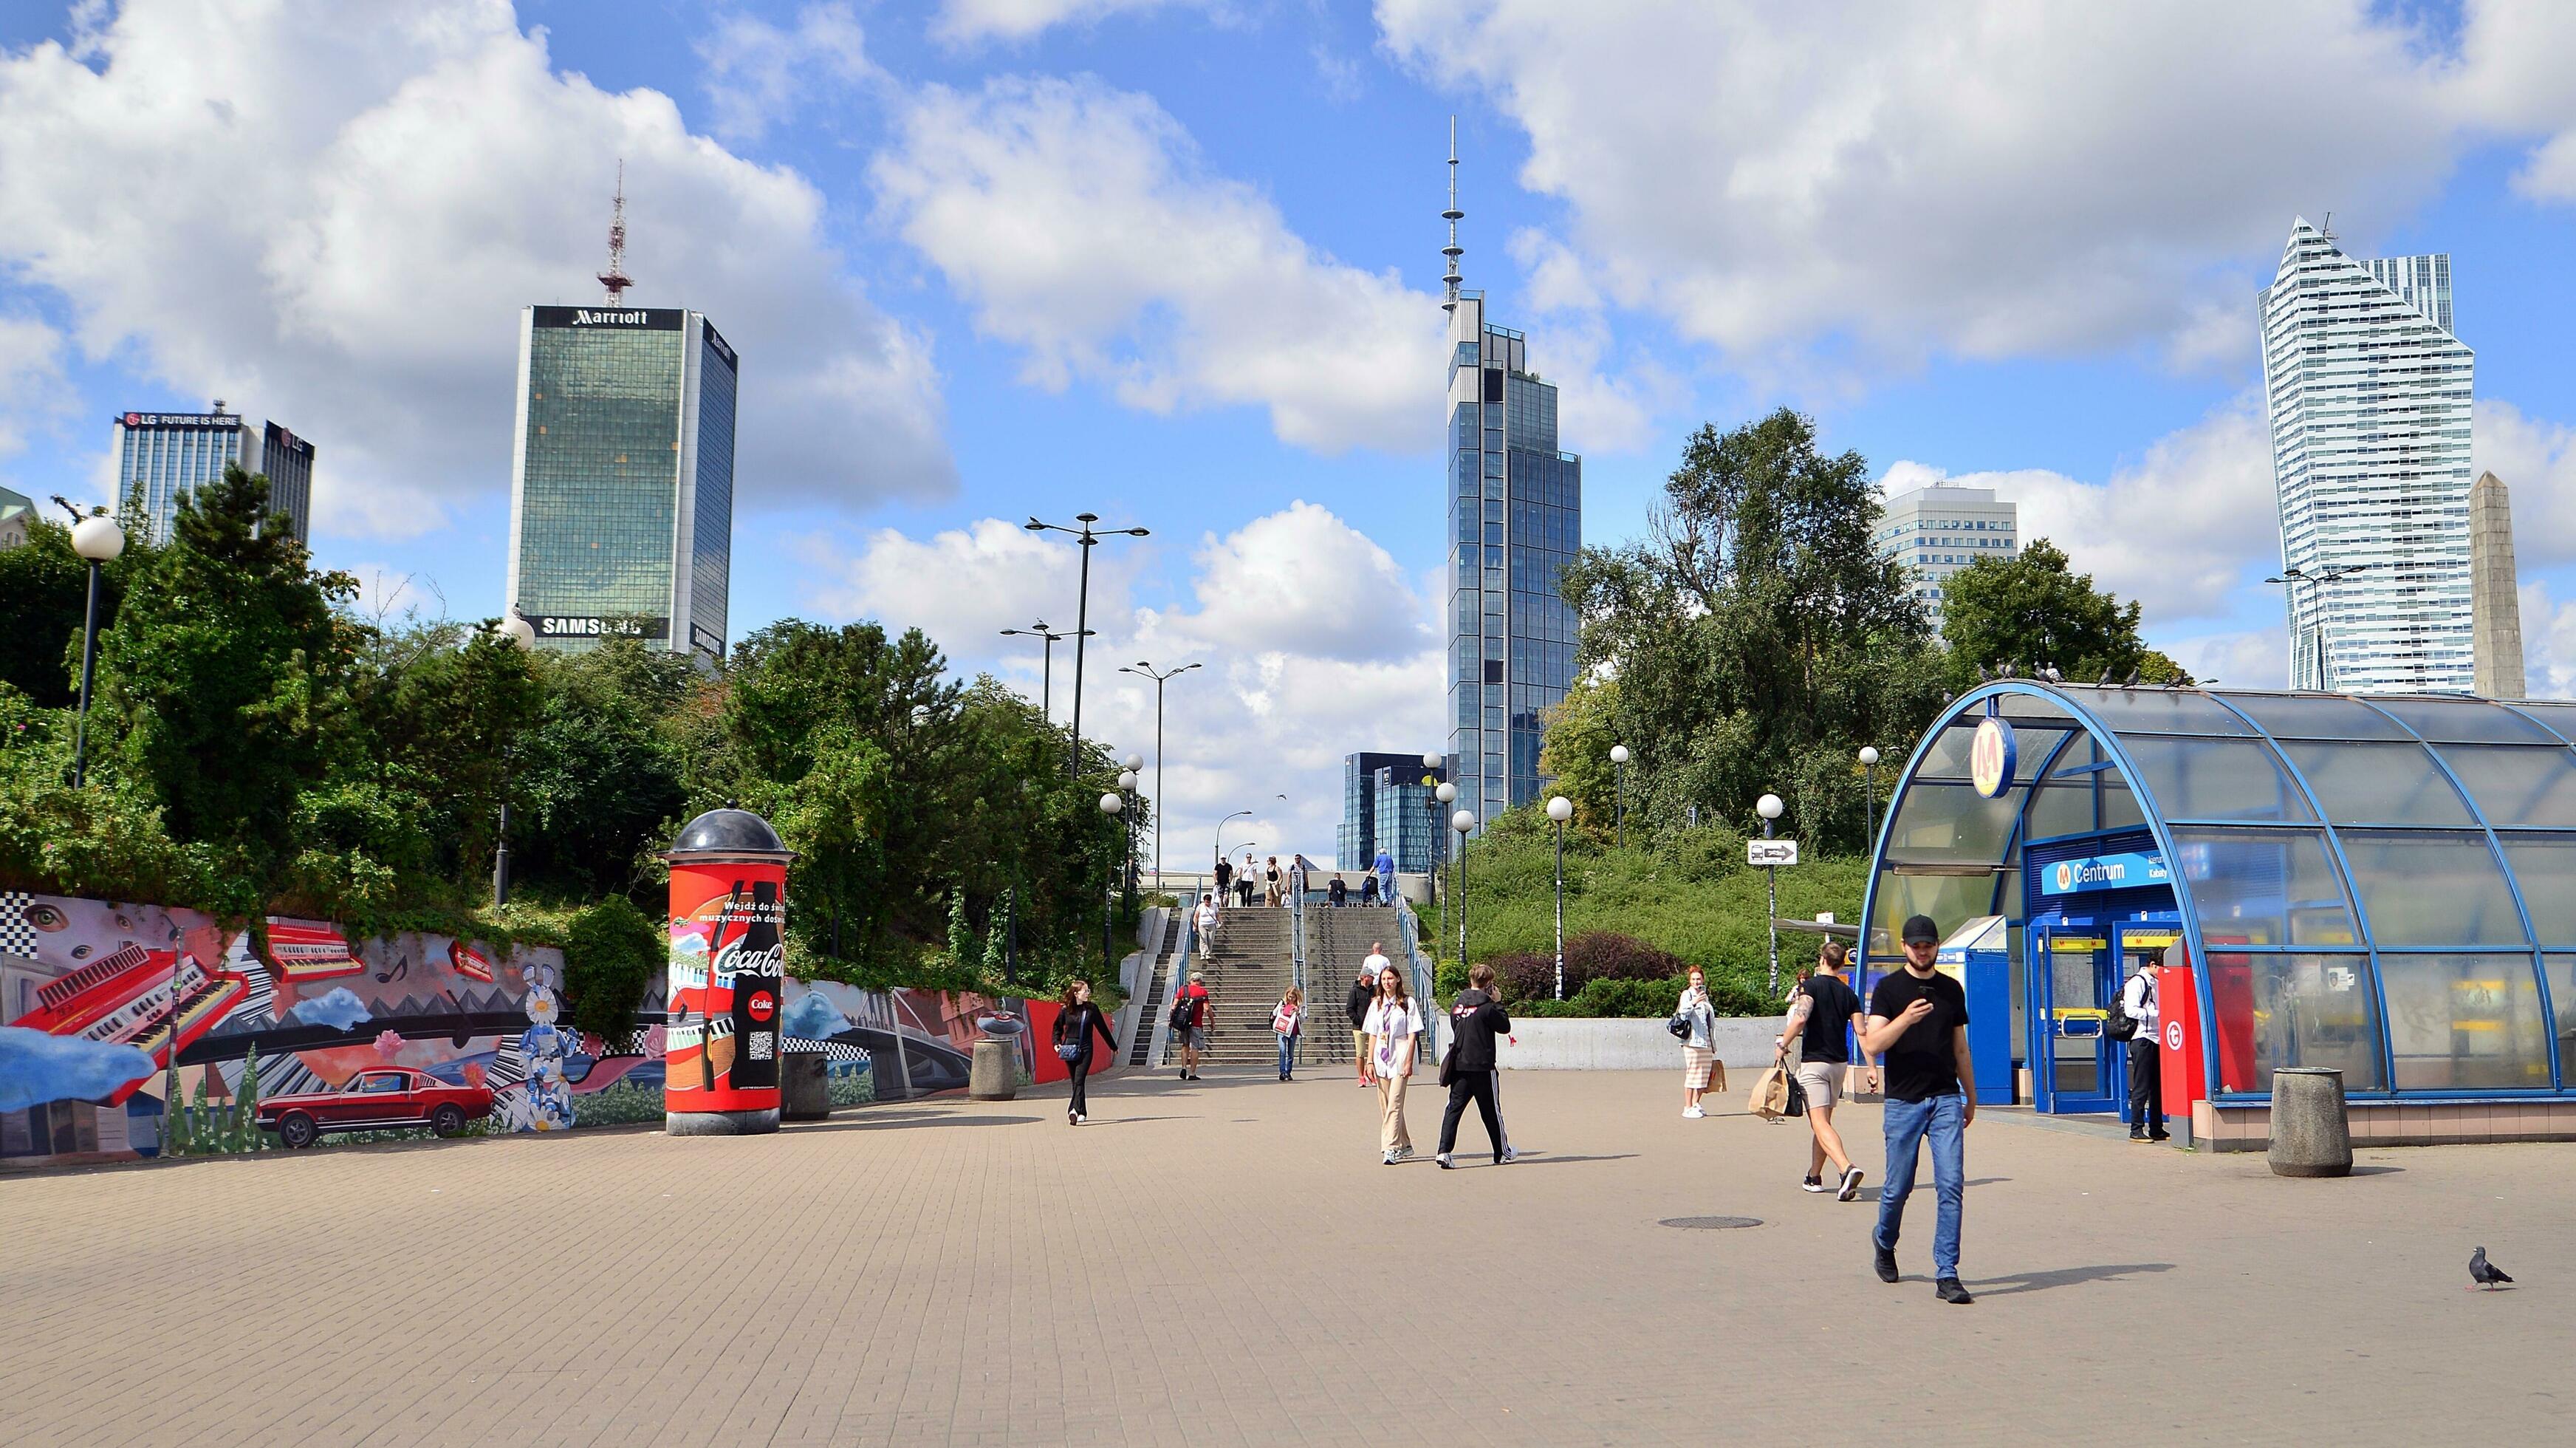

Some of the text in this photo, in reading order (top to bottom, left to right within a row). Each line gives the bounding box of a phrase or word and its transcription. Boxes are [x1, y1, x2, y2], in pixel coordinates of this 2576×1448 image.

[572, 310, 648, 325] Marriott
[711, 331, 730, 361] Marriott
[141, 414, 237, 426] LG FUTURE IS HERE
[292, 435, 303, 452] LG
[695, 628, 720, 655] SAMSUNG
[2074, 864, 2125, 884] Centrum
[724, 901, 756, 912] Wejdź
[758, 902, 769, 911] do
[699, 914, 761, 923] muzycznych
[713, 942, 784, 978] Coca-Col
[751, 999, 773, 1009] Coke
